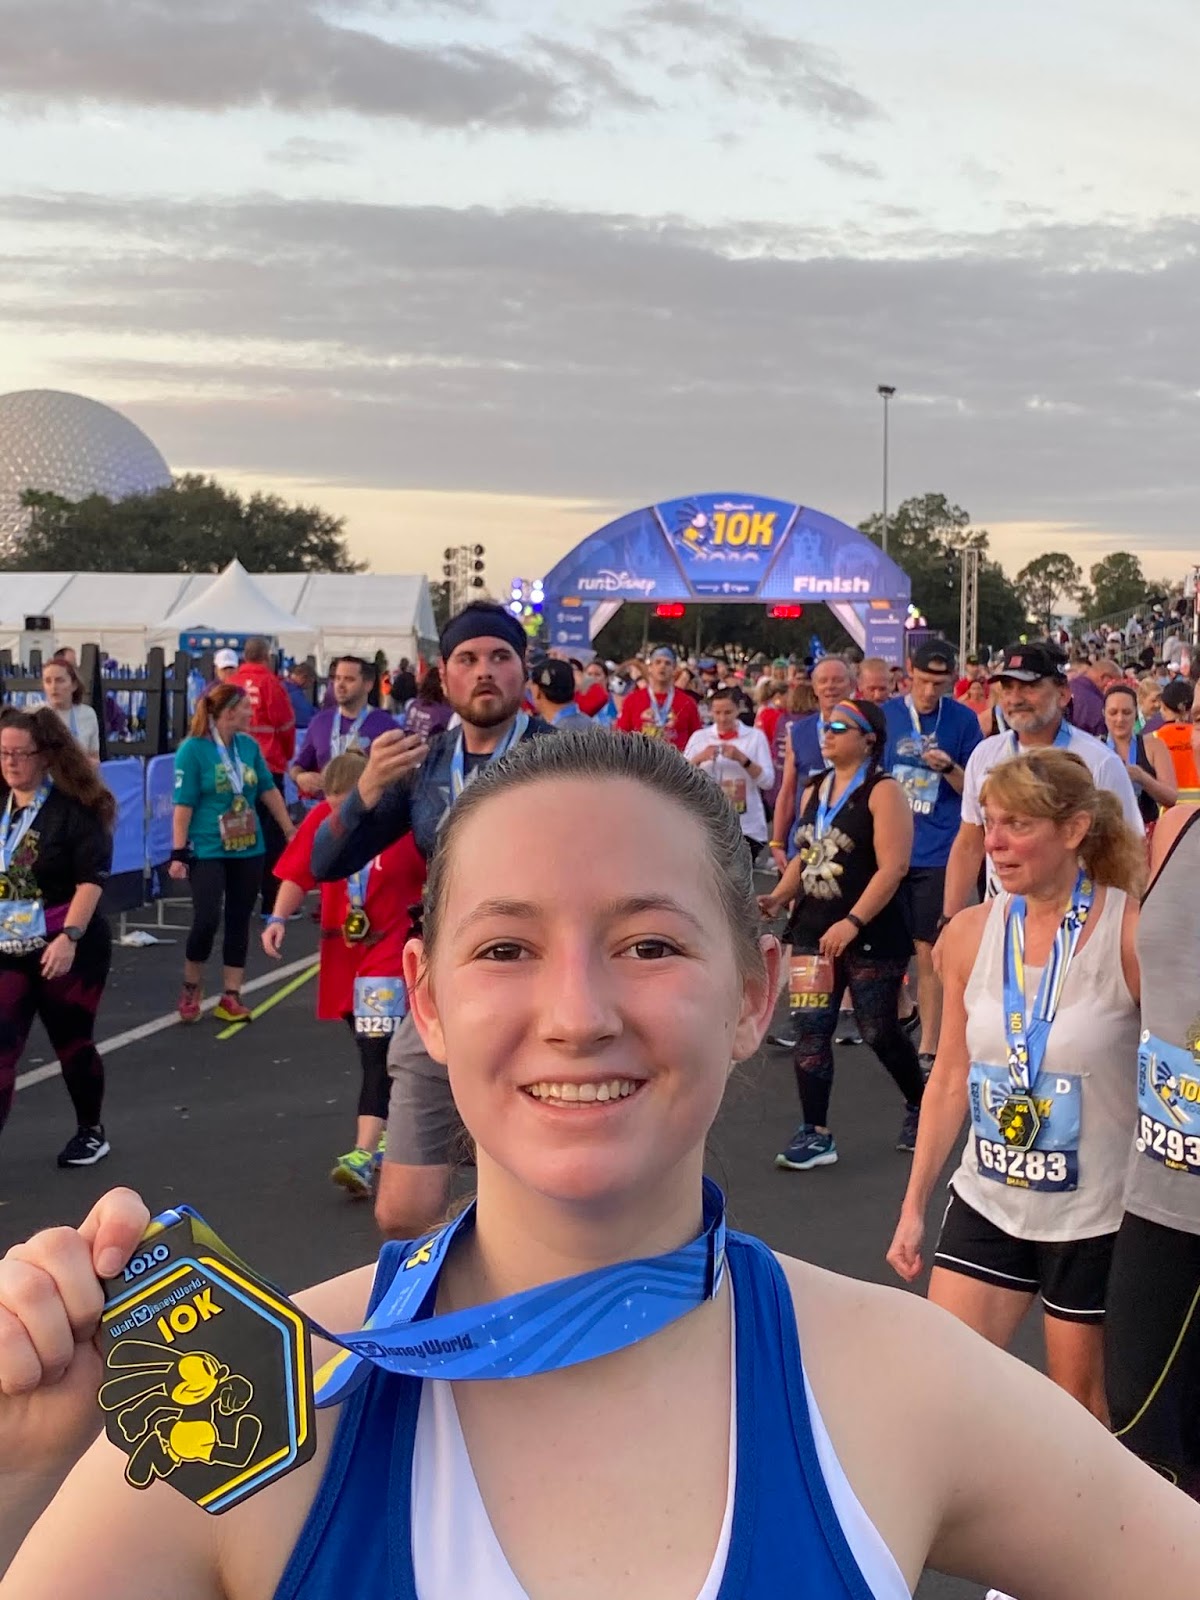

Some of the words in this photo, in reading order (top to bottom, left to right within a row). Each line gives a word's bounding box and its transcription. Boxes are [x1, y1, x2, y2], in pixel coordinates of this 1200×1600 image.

[713, 511, 776, 546] 10K
[793, 576, 870, 593] Finish
[1056, 1079, 1071, 1094] D
[980, 1139, 1067, 1182] 63283
[123, 1244, 169, 1282] 2020
[110, 1314, 135, 1338] Walt
[157, 1287, 225, 1344] 10K
